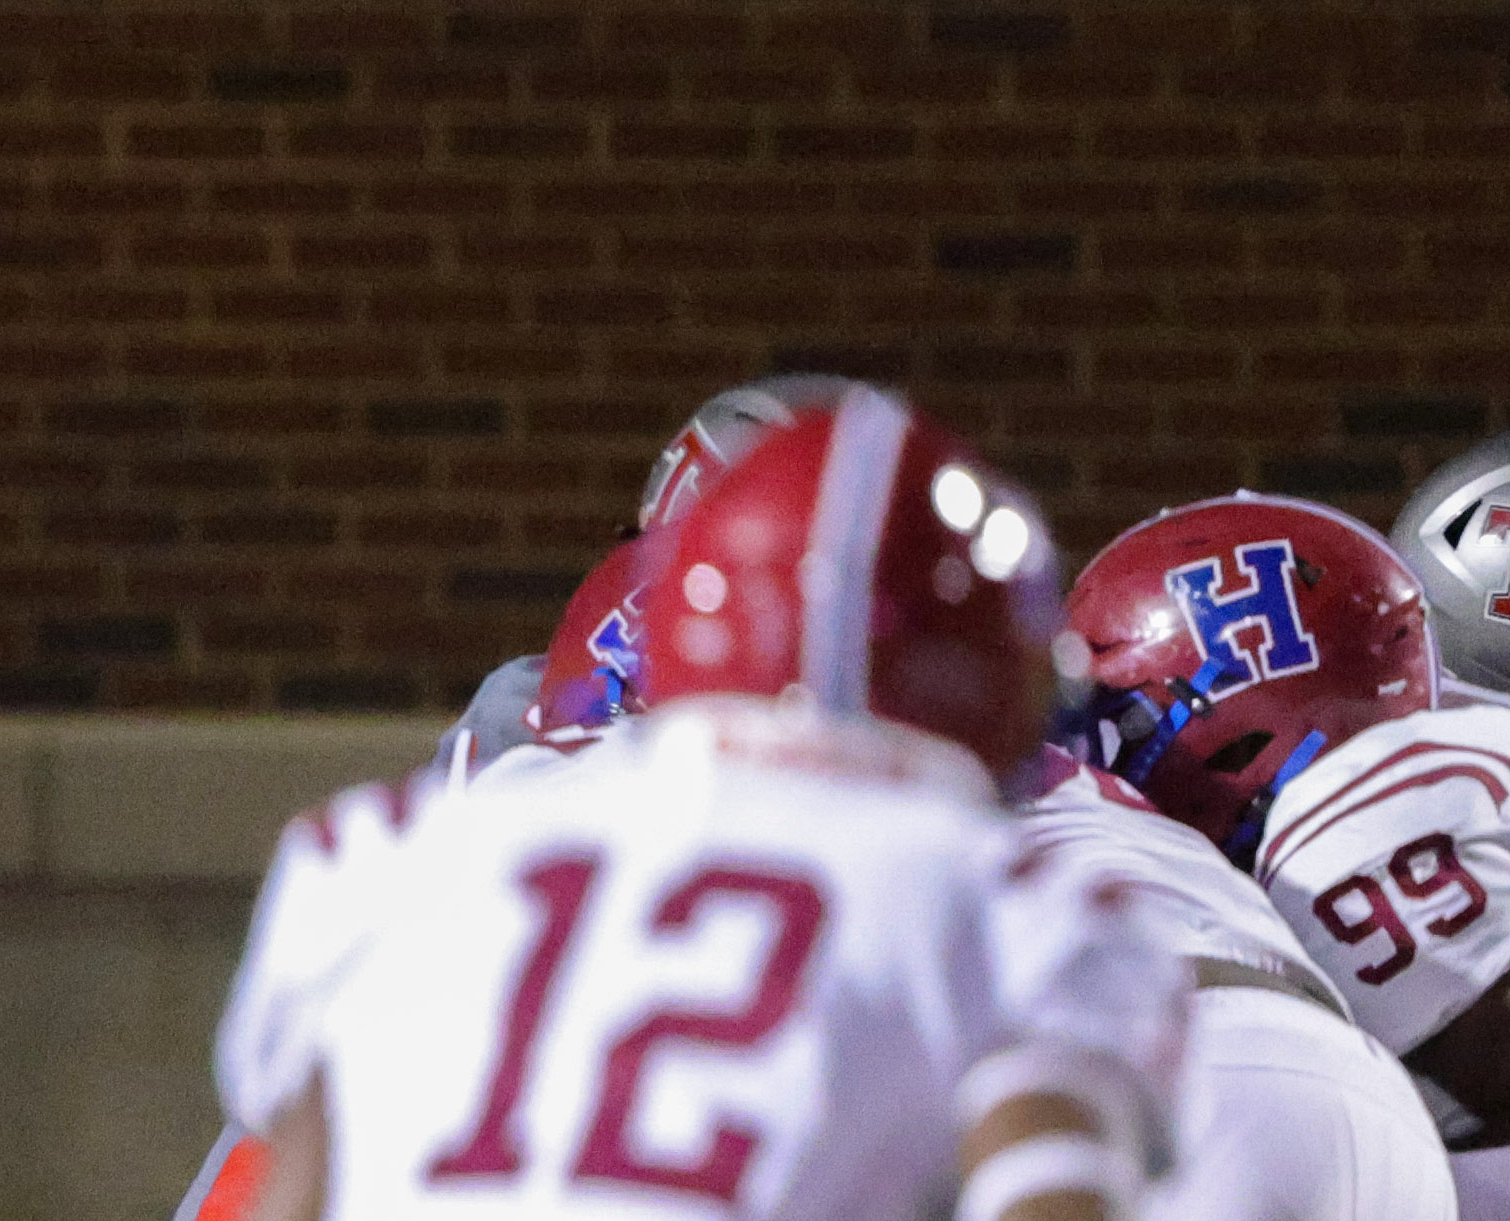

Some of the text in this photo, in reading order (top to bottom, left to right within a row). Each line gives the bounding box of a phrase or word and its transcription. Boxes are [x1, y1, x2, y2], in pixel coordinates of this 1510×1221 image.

[1165, 538, 1320, 704] H
[1312, 831, 1488, 986] 99
[427, 856, 825, 1203] 12
